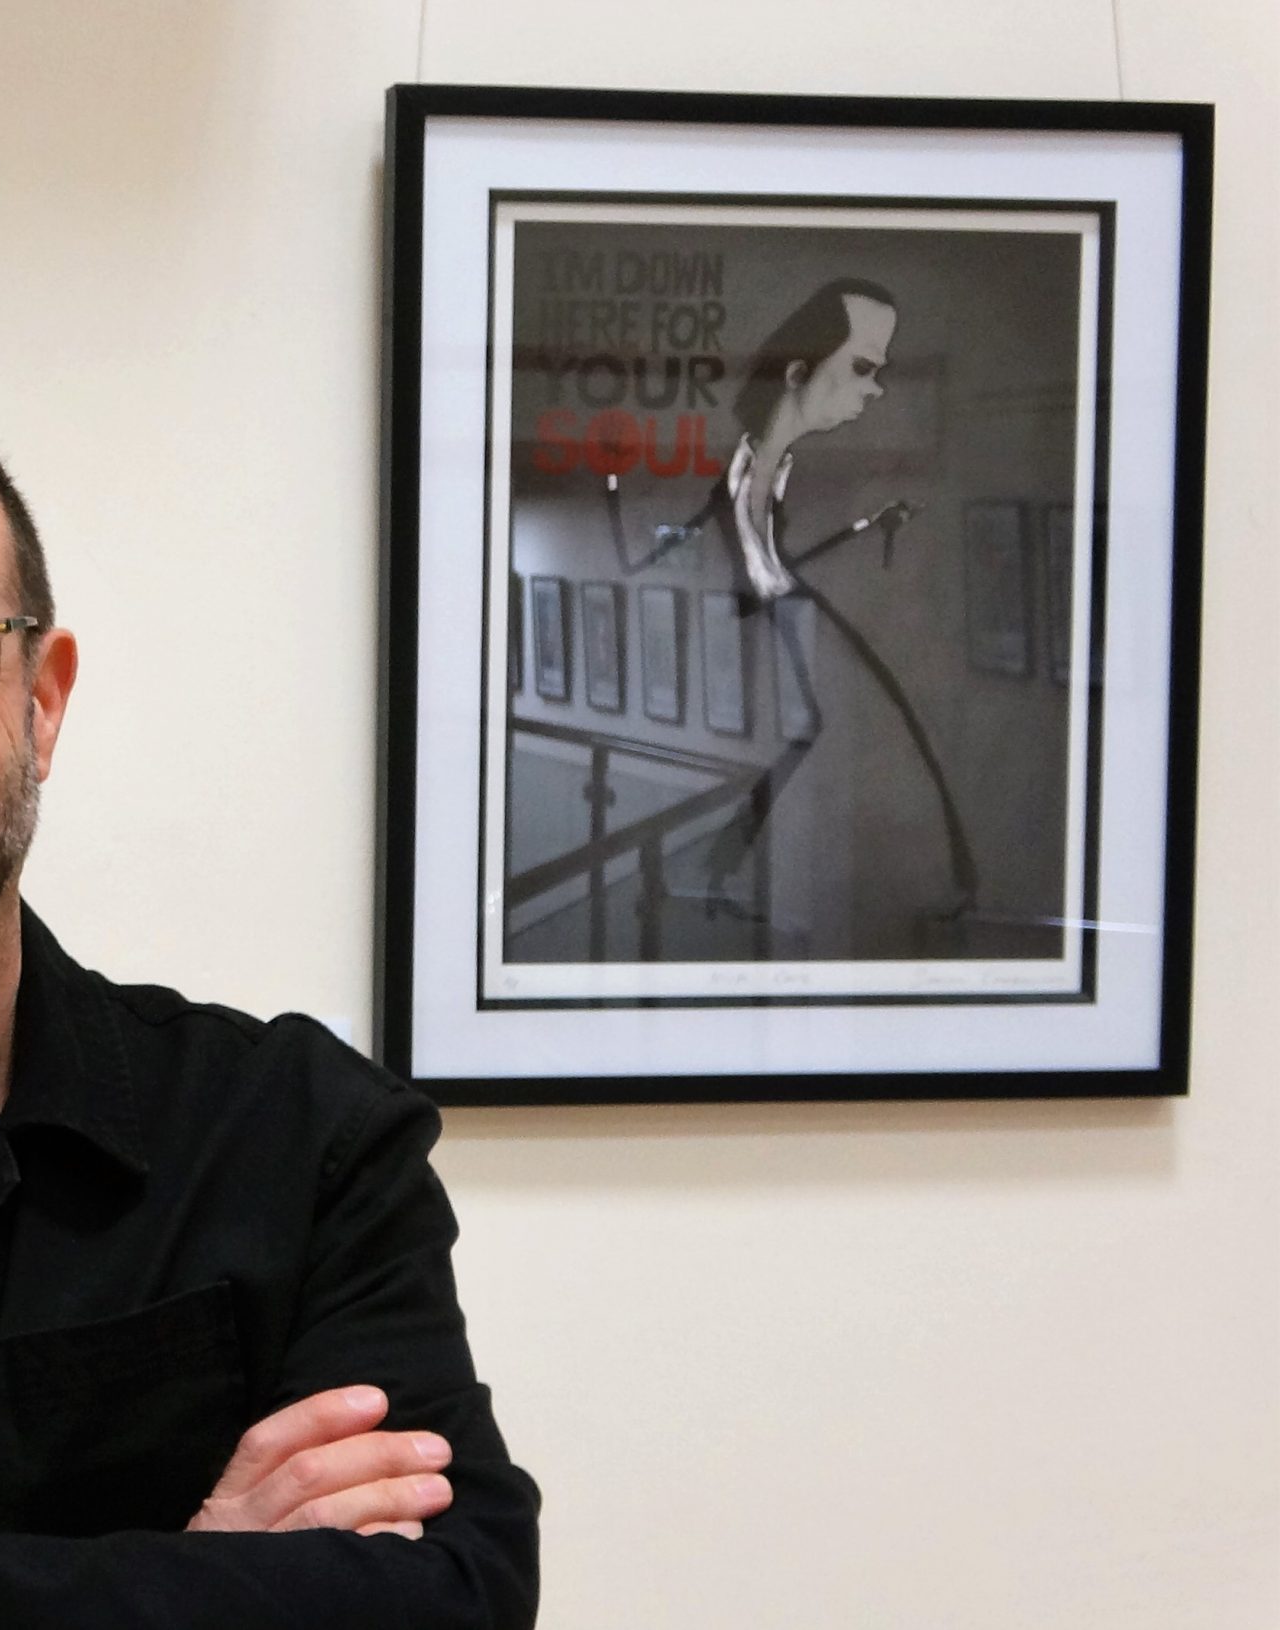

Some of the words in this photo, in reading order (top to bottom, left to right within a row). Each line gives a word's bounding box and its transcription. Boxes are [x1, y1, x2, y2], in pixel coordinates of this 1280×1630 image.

[616, 250, 725, 296] DOWN
[539, 299, 641, 350] HERE
[650, 301, 728, 353] FOR
[535, 353, 726, 410] YOUR
[532, 409, 723, 478] SOUL
